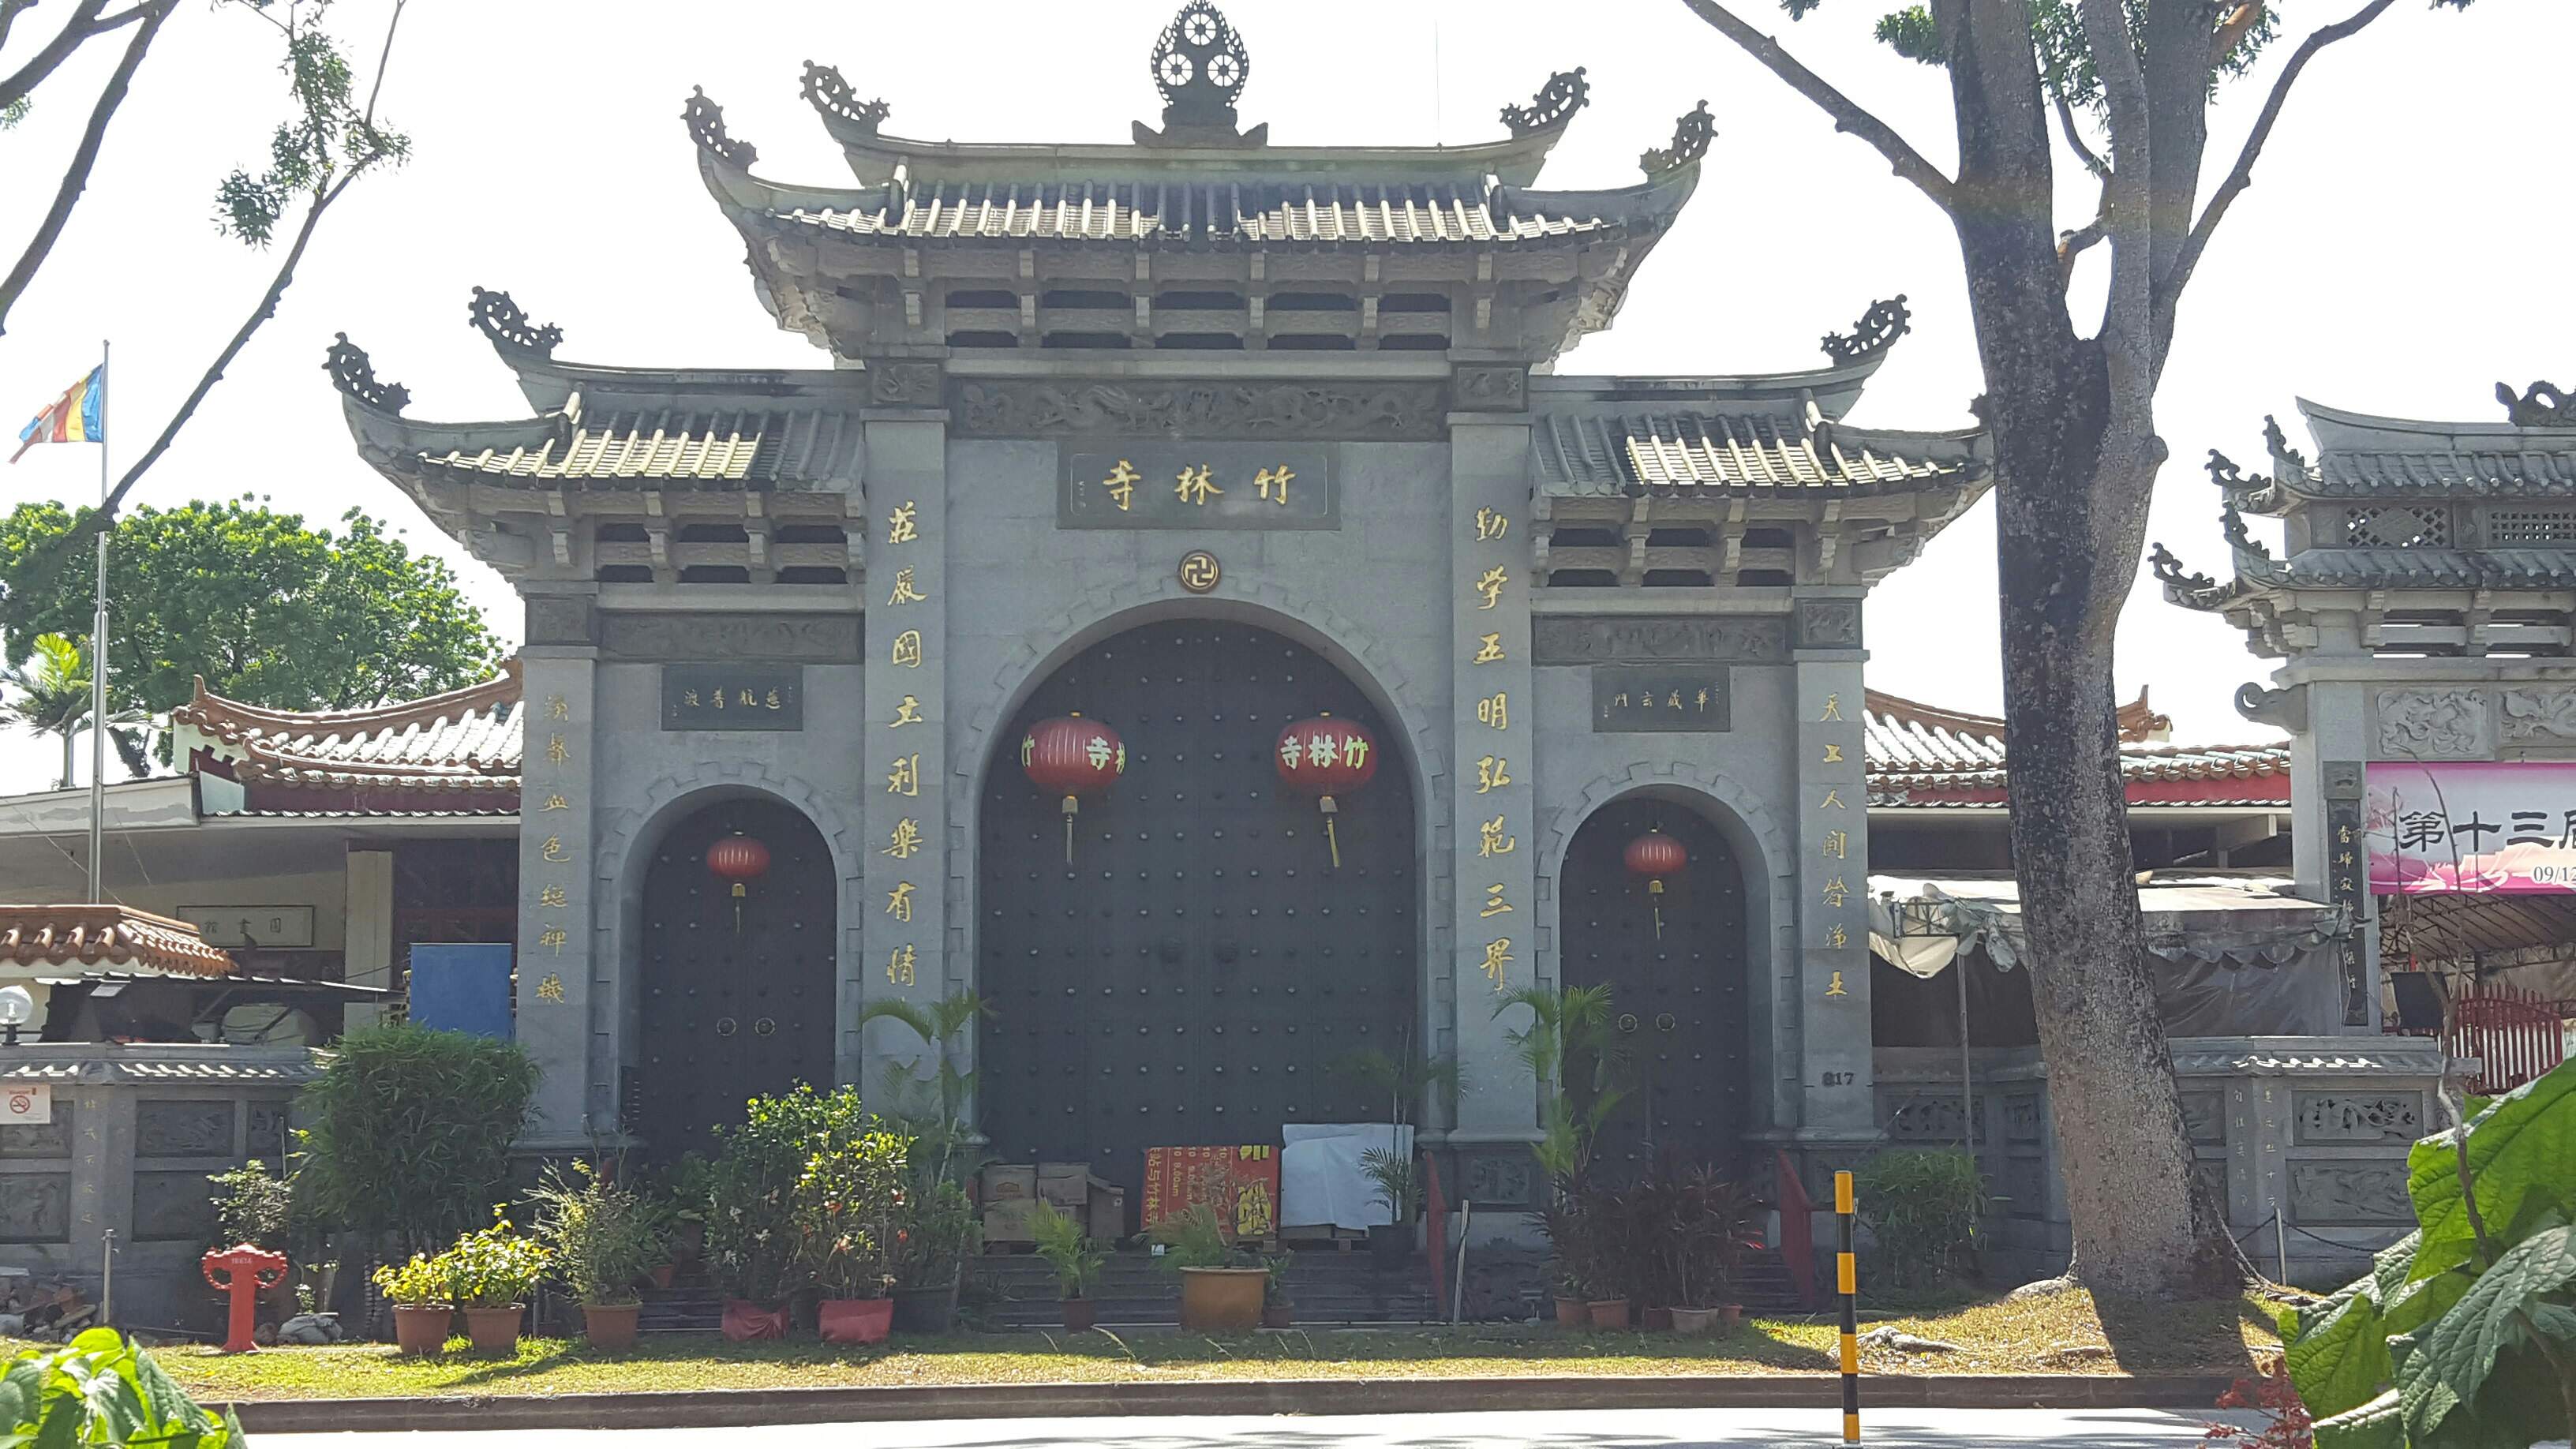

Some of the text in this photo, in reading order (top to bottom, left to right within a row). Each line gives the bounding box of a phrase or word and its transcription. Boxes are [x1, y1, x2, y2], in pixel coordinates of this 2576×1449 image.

[1103, 459, 1297, 511] 竹林寺
[1279, 733, 1369, 770] 竹林寺
